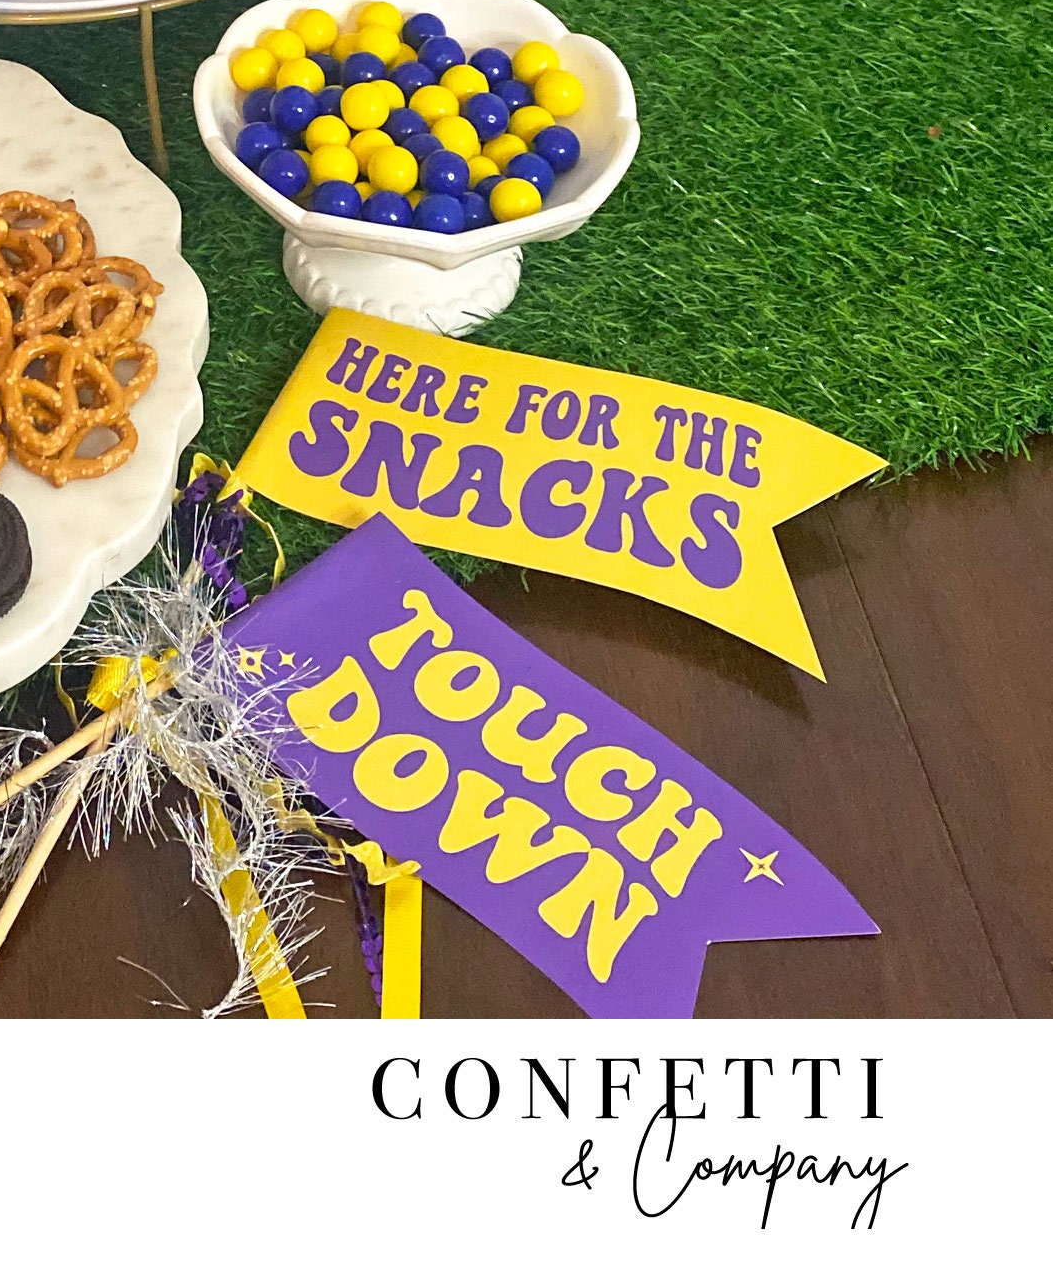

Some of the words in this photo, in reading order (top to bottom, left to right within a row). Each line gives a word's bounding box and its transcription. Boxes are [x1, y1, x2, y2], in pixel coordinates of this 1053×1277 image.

[288, 399, 743, 589] SNACKS
[327, 337, 488, 424] HERE
[504, 384, 620, 450] FOR
[654, 404, 762, 488] THE
[286, 655, 659, 984] DOWN
[369, 589, 723, 899] TOUCH
